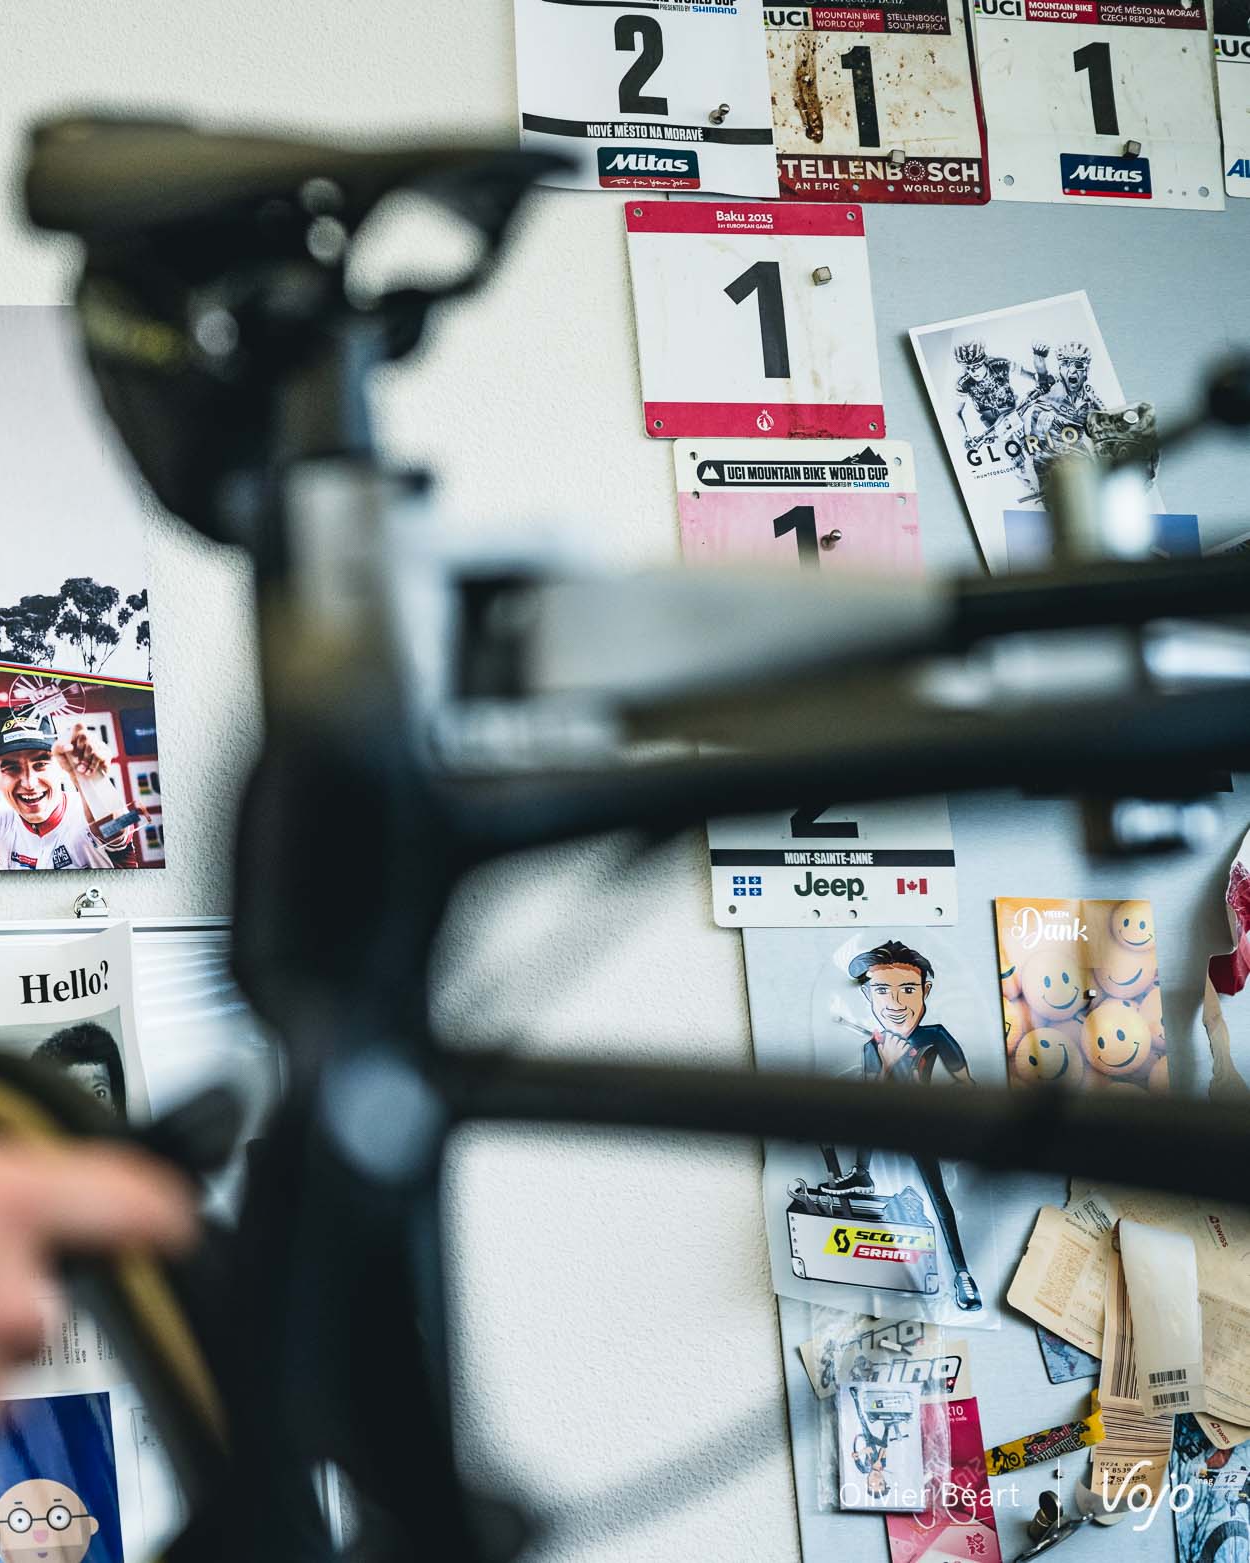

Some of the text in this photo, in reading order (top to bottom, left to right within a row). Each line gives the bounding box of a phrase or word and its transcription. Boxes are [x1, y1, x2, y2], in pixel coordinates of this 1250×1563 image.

[692, 5, 738, 15] SHIMANO
[982, 0, 1093, 16] UCI MOUNTAIN BIKE
[1029, 10, 1078, 20] WORLD CUP
[1101, 5, 1123, 14] NOVÉ
[1124, 6, 1152, 15] MĚSTO
[1154, 8, 1165, 16] NA
[768, 10, 881, 27] UCI MOUNTAIN BIKE
[816, 20, 847, 28] WORLD
[886, 13, 947, 23] STELLENBOSCH
[1101, 14, 1166, 24] CZECH REPUBLIC
[887, 21, 945, 31] SOUTH AFRICA
[614, 14, 669, 116] 2
[841, 45, 880, 148] 1
[1073, 41, 1120, 137] 1
[586, 122, 612, 137] NOVÉ
[615, 123, 648, 139] MĚSTO
[650, 127, 663, 139] NA
[606, 153, 689, 172] Mitas
[1069, 165, 1143, 183] Mitas
[795, 182, 971, 193] AN EPIC WORLD CUP
[716, 210, 773, 223] Baku 2015
[723, 261, 791, 378] 1
[967, 426, 1079, 467] GLORIO
[727, 466, 889, 481] UCI MOUNTAIN BIKE WORLD CUP
[784, 852, 874, 865] MONT-SAINTE-ANNE
[794, 871, 866, 901] Jeep
[1010, 907, 1089, 951] Dank
[19, 960, 109, 1004] Hello?
[854, 1231, 921, 1245] SCOTT
[858, 1247, 911, 1260] SRAM
